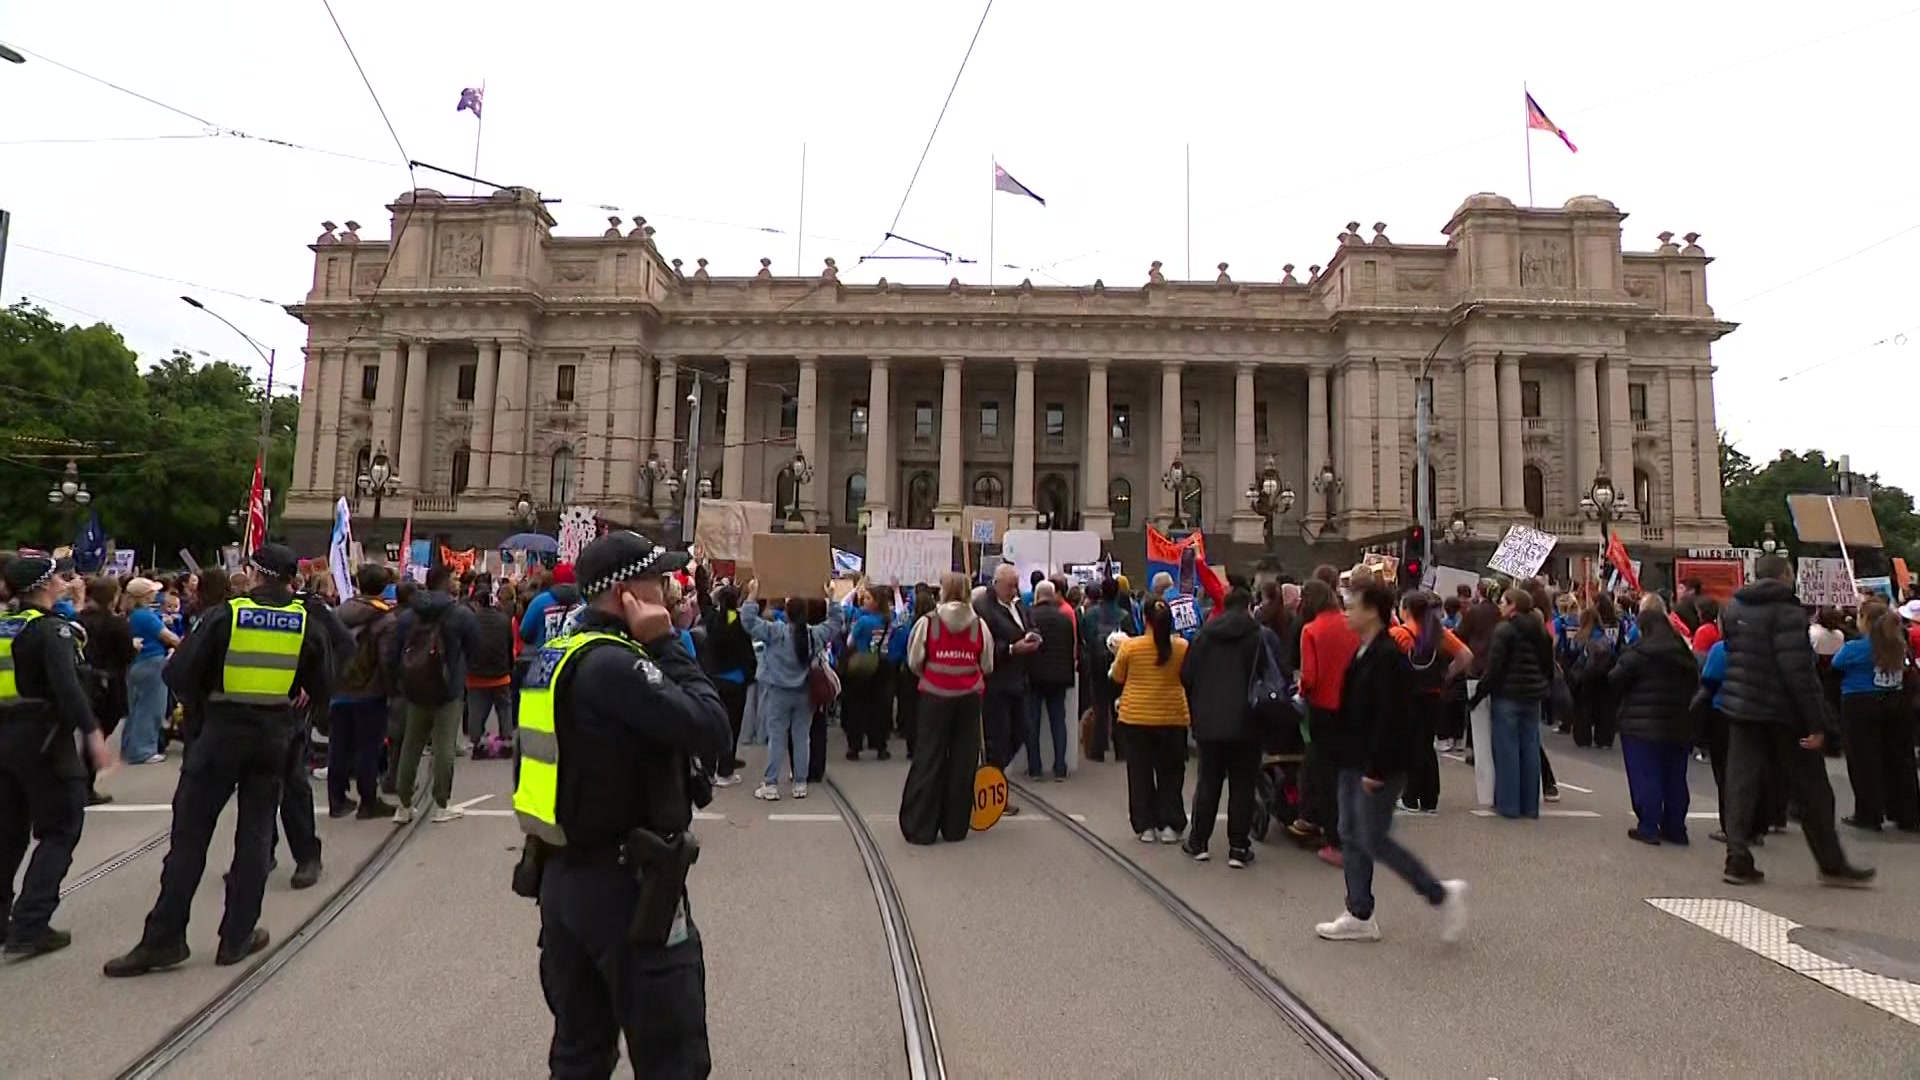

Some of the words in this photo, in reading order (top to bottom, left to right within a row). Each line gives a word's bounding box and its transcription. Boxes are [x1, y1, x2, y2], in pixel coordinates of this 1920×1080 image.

[1800, 581, 1825, 591] TURN
[1803, 592, 1825, 604] OUT
[1831, 593, 1853, 604] OUT
[239, 609, 300, 629] Police
[936, 650, 975, 660] MARSHAL
[974, 782, 1005, 811] SLO
